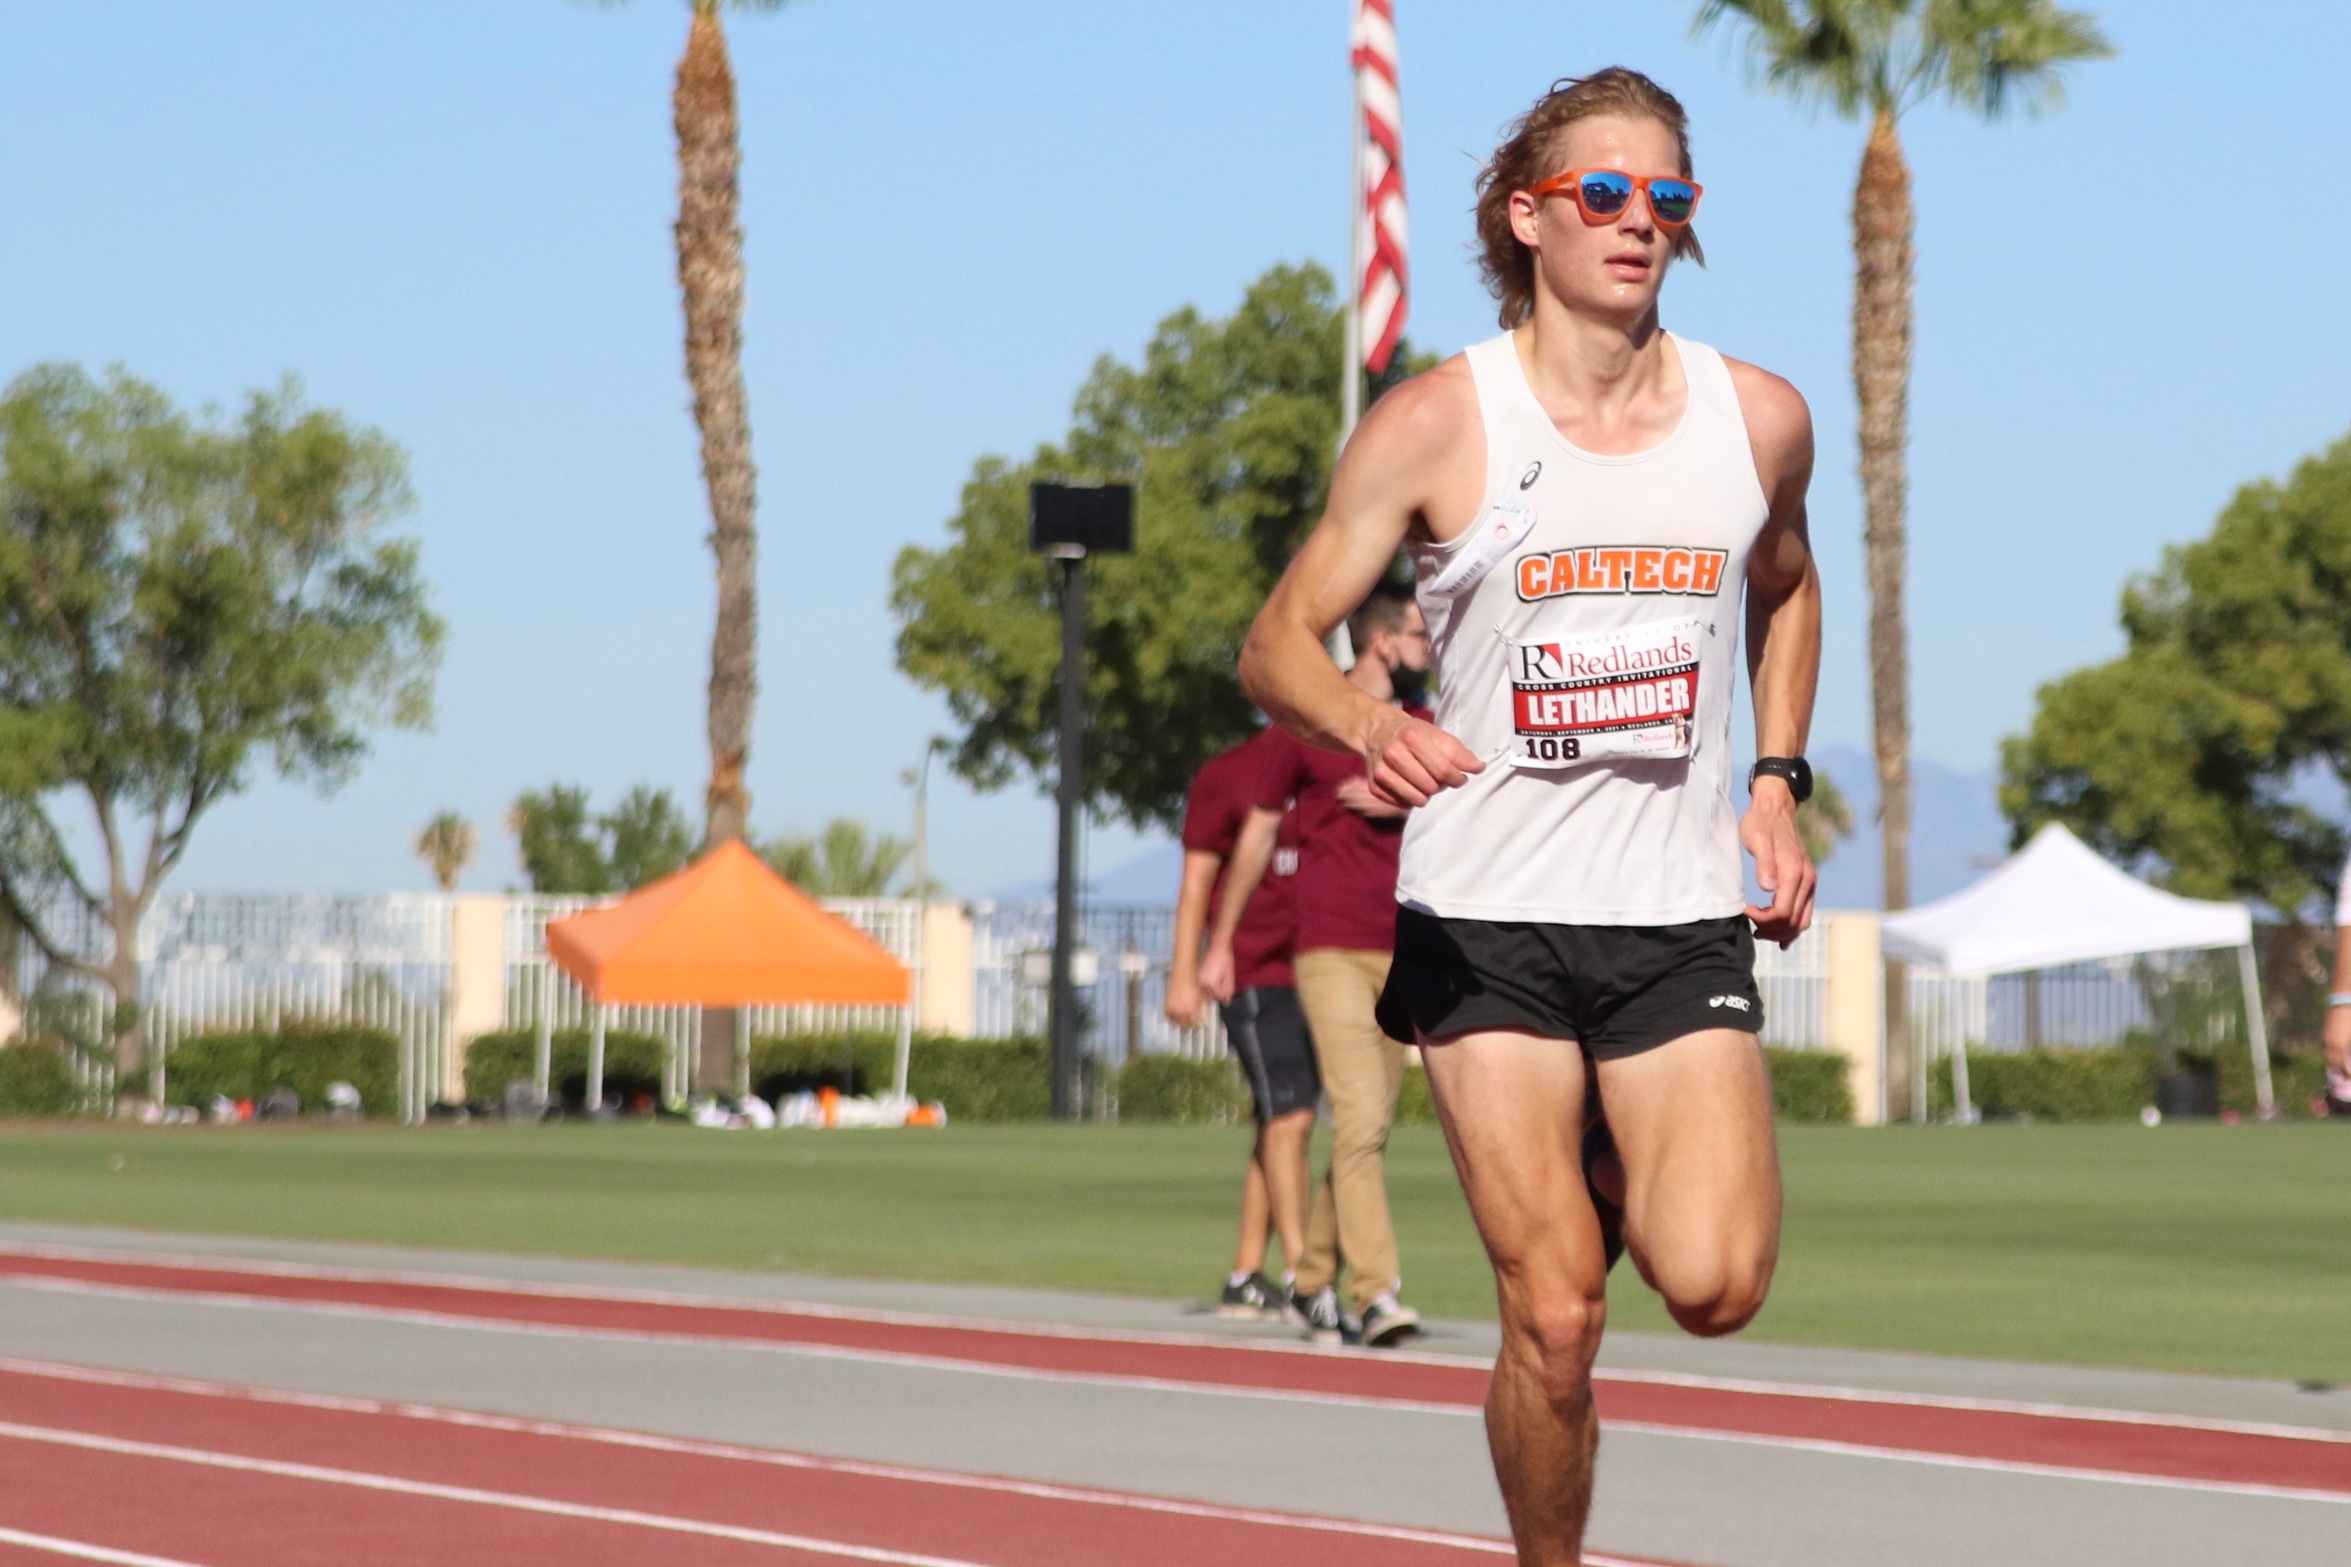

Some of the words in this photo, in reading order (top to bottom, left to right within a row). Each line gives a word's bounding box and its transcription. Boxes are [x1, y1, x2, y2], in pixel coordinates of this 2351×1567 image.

[1515, 546, 1729, 602] CALTECH
[1560, 677, 1613, 690] COUNTRY
[1617, 664, 1693, 683] INVITATIONAL
[1567, 636, 1693, 678] Redlands
[1528, 678, 1690, 725] LETHANDER
[1526, 738, 1581, 760] 108
